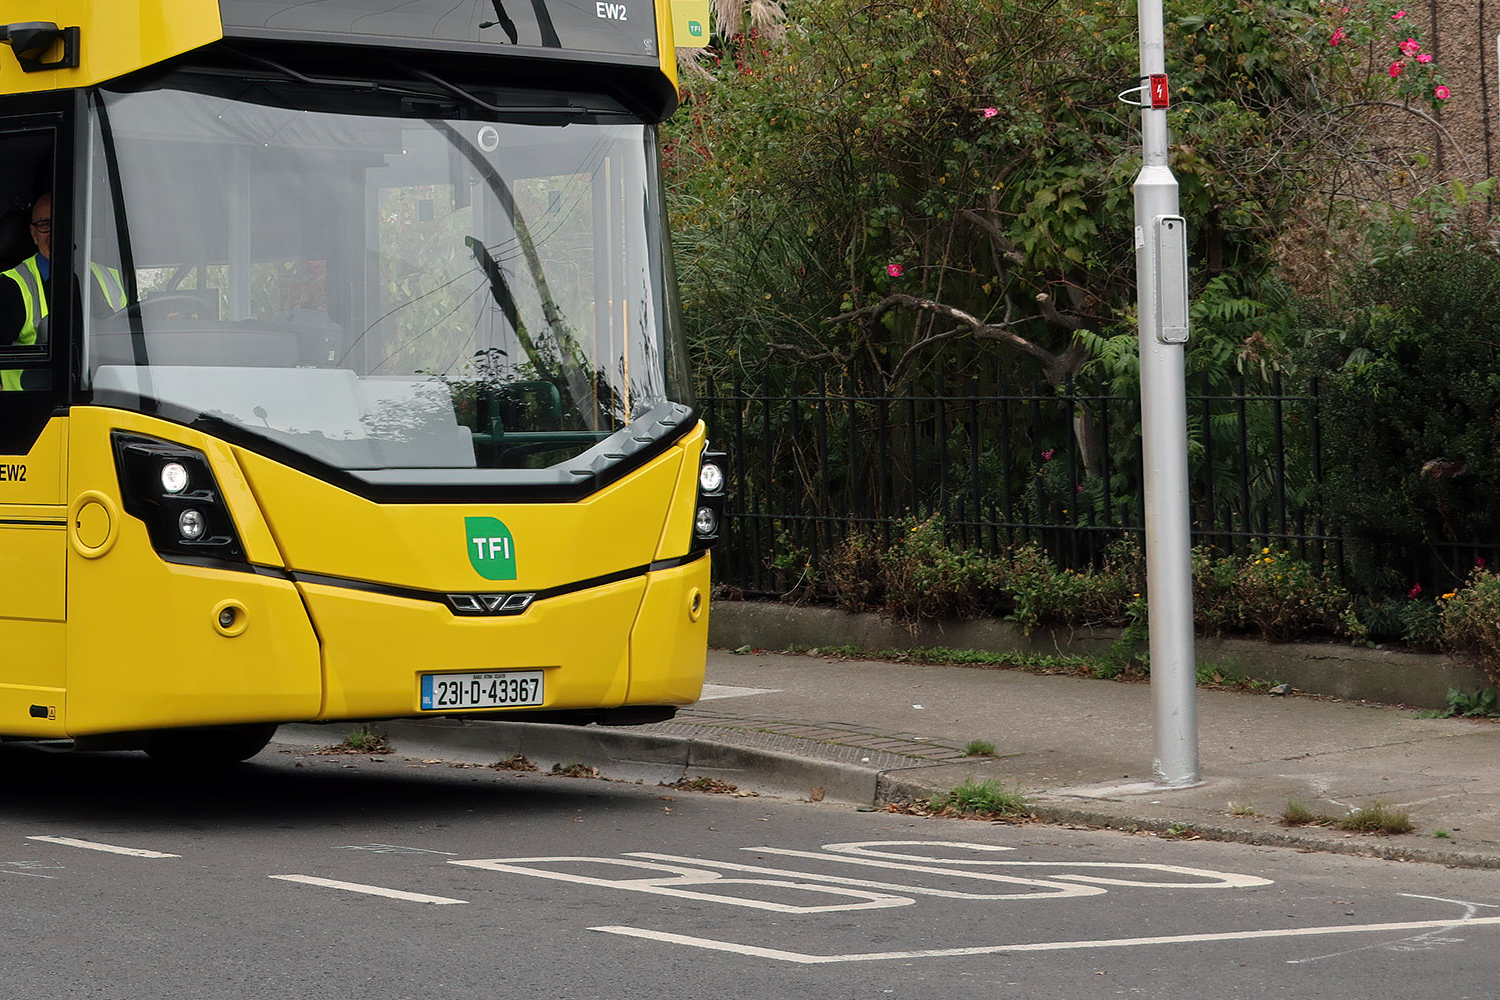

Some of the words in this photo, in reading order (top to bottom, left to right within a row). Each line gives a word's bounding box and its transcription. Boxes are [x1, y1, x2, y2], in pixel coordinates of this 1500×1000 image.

[596, 1, 628, 21] EW2
[472, 537, 510, 560] TFI
[437, 678, 539, 706] 231-D-43367
[446, 839, 1275, 914] BUS
